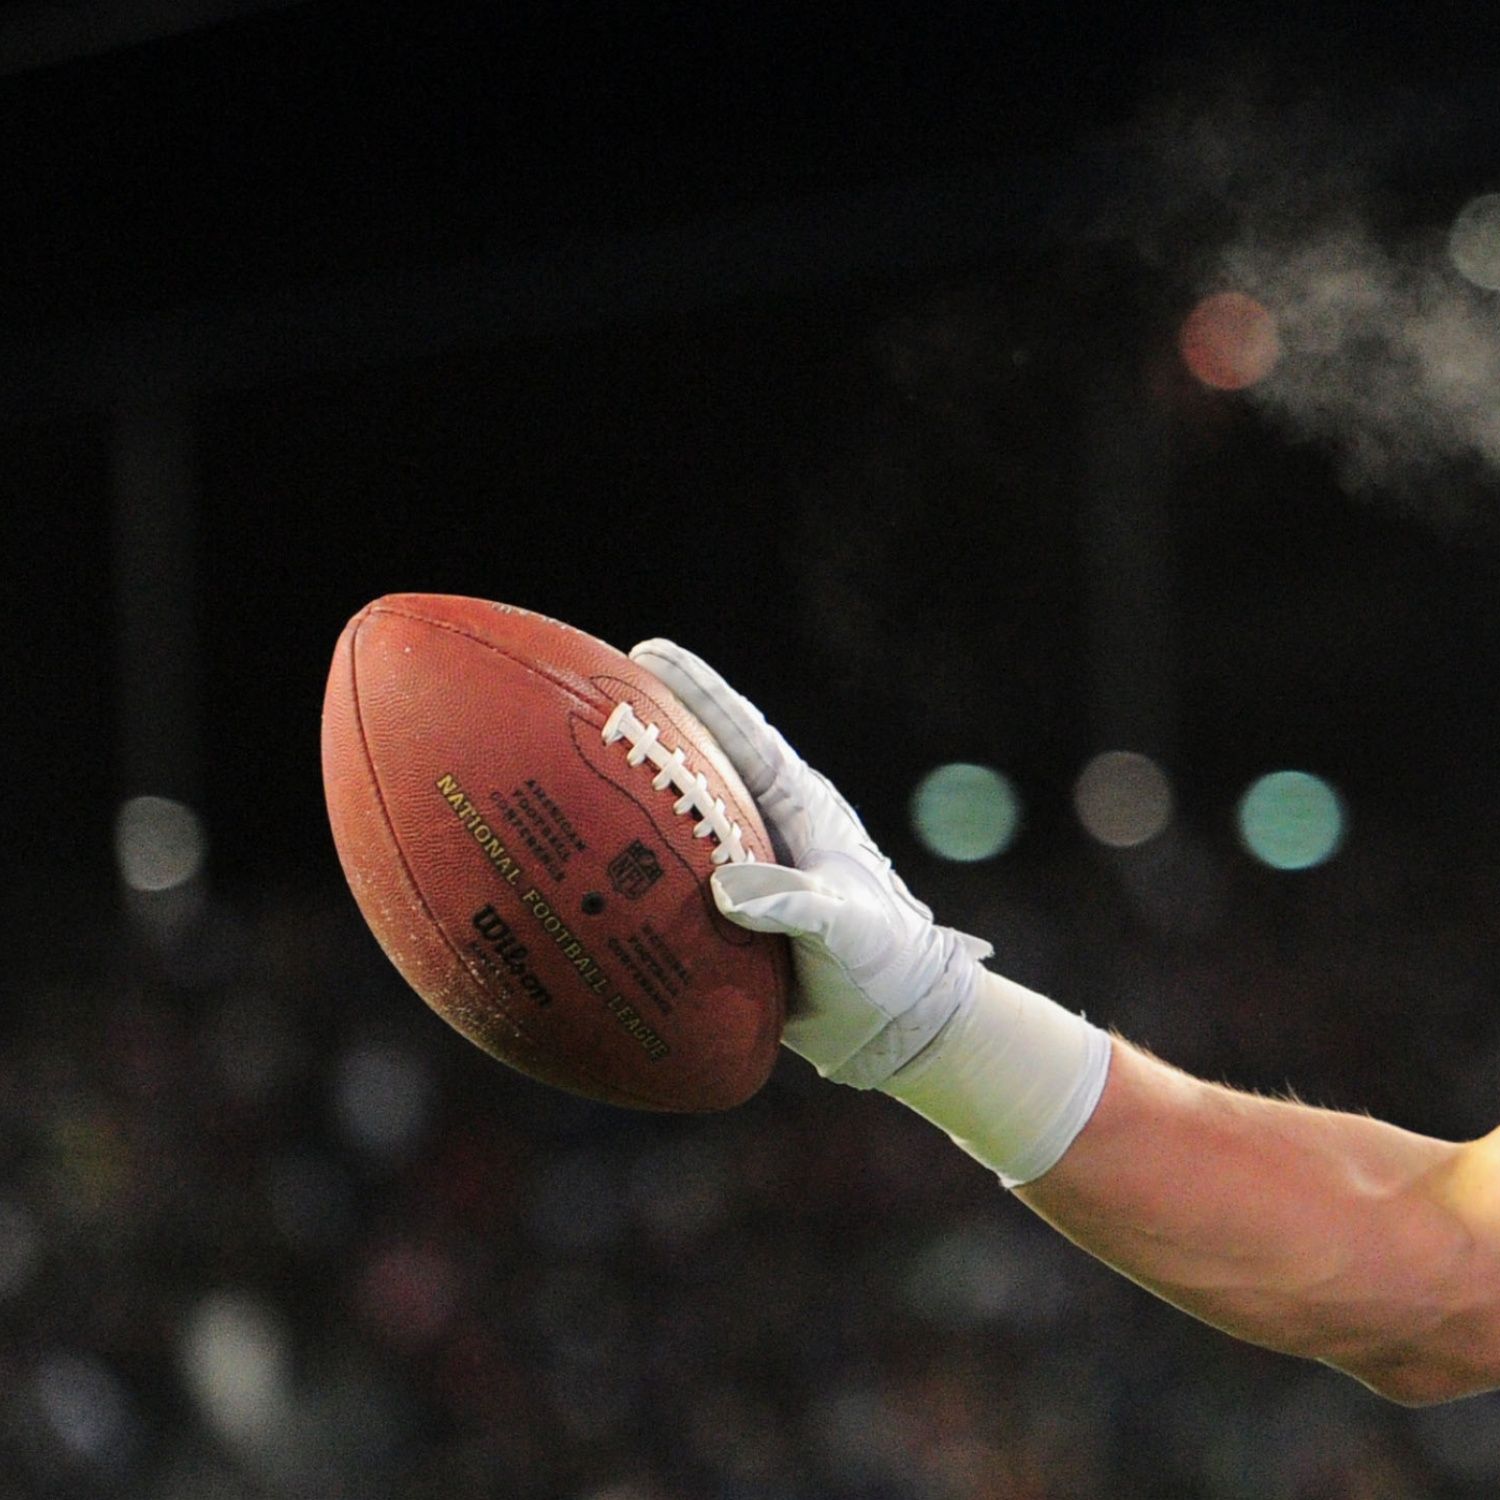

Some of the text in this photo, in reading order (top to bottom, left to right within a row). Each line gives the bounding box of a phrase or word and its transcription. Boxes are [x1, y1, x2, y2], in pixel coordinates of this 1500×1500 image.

[513, 790, 571, 861] FOOTBALL
[525, 779, 586, 851] AMERICAN
[436, 774, 523, 885] NATIONAL
[522, 889, 609, 993] FOOTBALL
[608, 995, 668, 1060] LEAGUE
[473, 904, 553, 1008] Wilson
